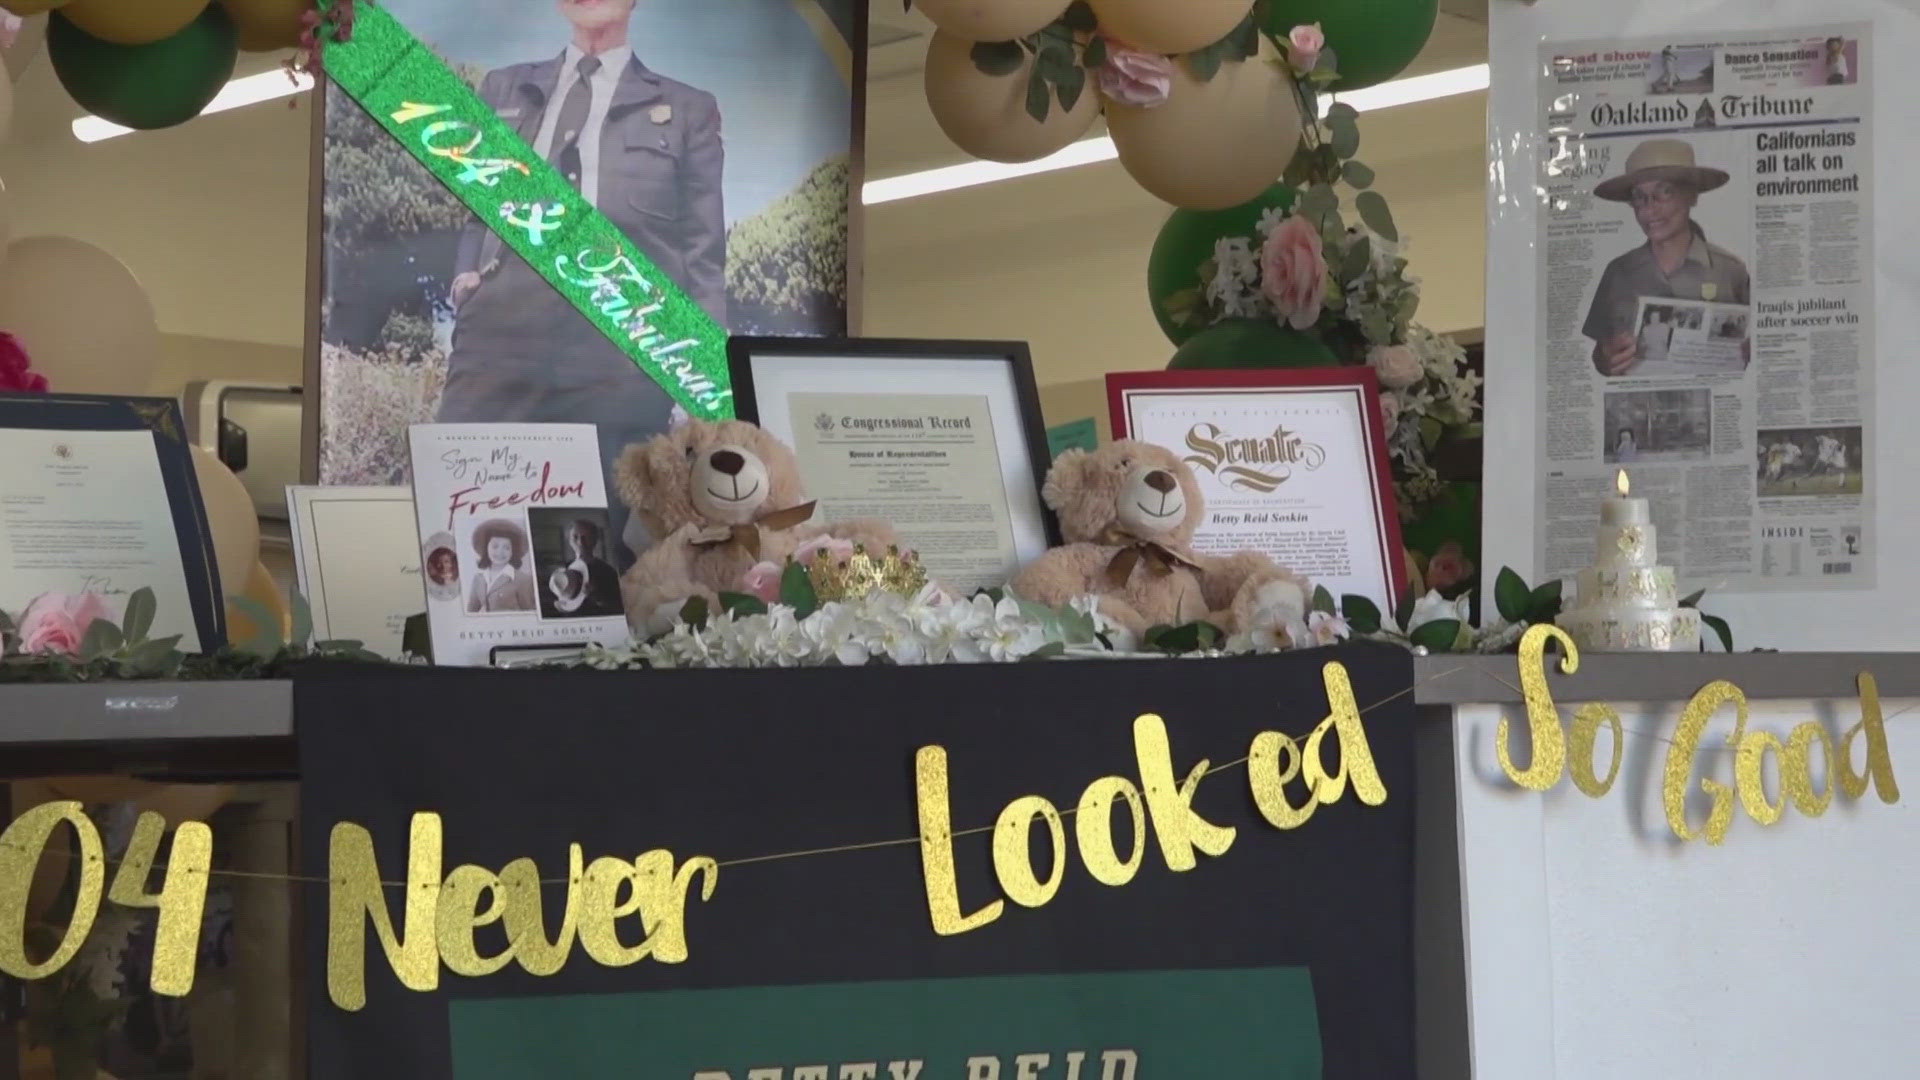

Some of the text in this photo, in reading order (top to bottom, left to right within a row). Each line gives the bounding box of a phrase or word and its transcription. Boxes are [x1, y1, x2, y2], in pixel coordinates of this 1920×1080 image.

[1554, 50, 1651, 66] Rad show
[1724, 50, 1819, 65] Dance Sensation
[1590, 98, 1689, 128] Oakland
[1720, 95, 1814, 119] Tribune
[1756, 129, 1857, 151] Californians
[1756, 152, 1844, 174] all talk on
[1756, 174, 1860, 197] environment
[390, 101, 733, 411] 104 & Fabulous
[1757, 298, 1847, 316] Iraqis jubilant
[1757, 313, 1859, 329] after soccer win
[841, 416, 972, 432] Congressional Record
[1183, 422, 1325, 476] Senate
[440, 446, 520, 479] Sign My
[474, 460, 538, 486] Name to
[448, 461, 585, 531] Freedom
[1212, 511, 1309, 526] Betty Reid Soskin
[1761, 526, 1804, 538] INSIDE
[459, 625, 603, 640] BETTY REID SOSKIN
[327, 812, 719, 1012] Never
[915, 660, 1388, 936] Looked
[1495, 623, 1624, 799] So
[1662, 670, 1901, 847] Good
[693, 1060, 924, 1080] TTY
